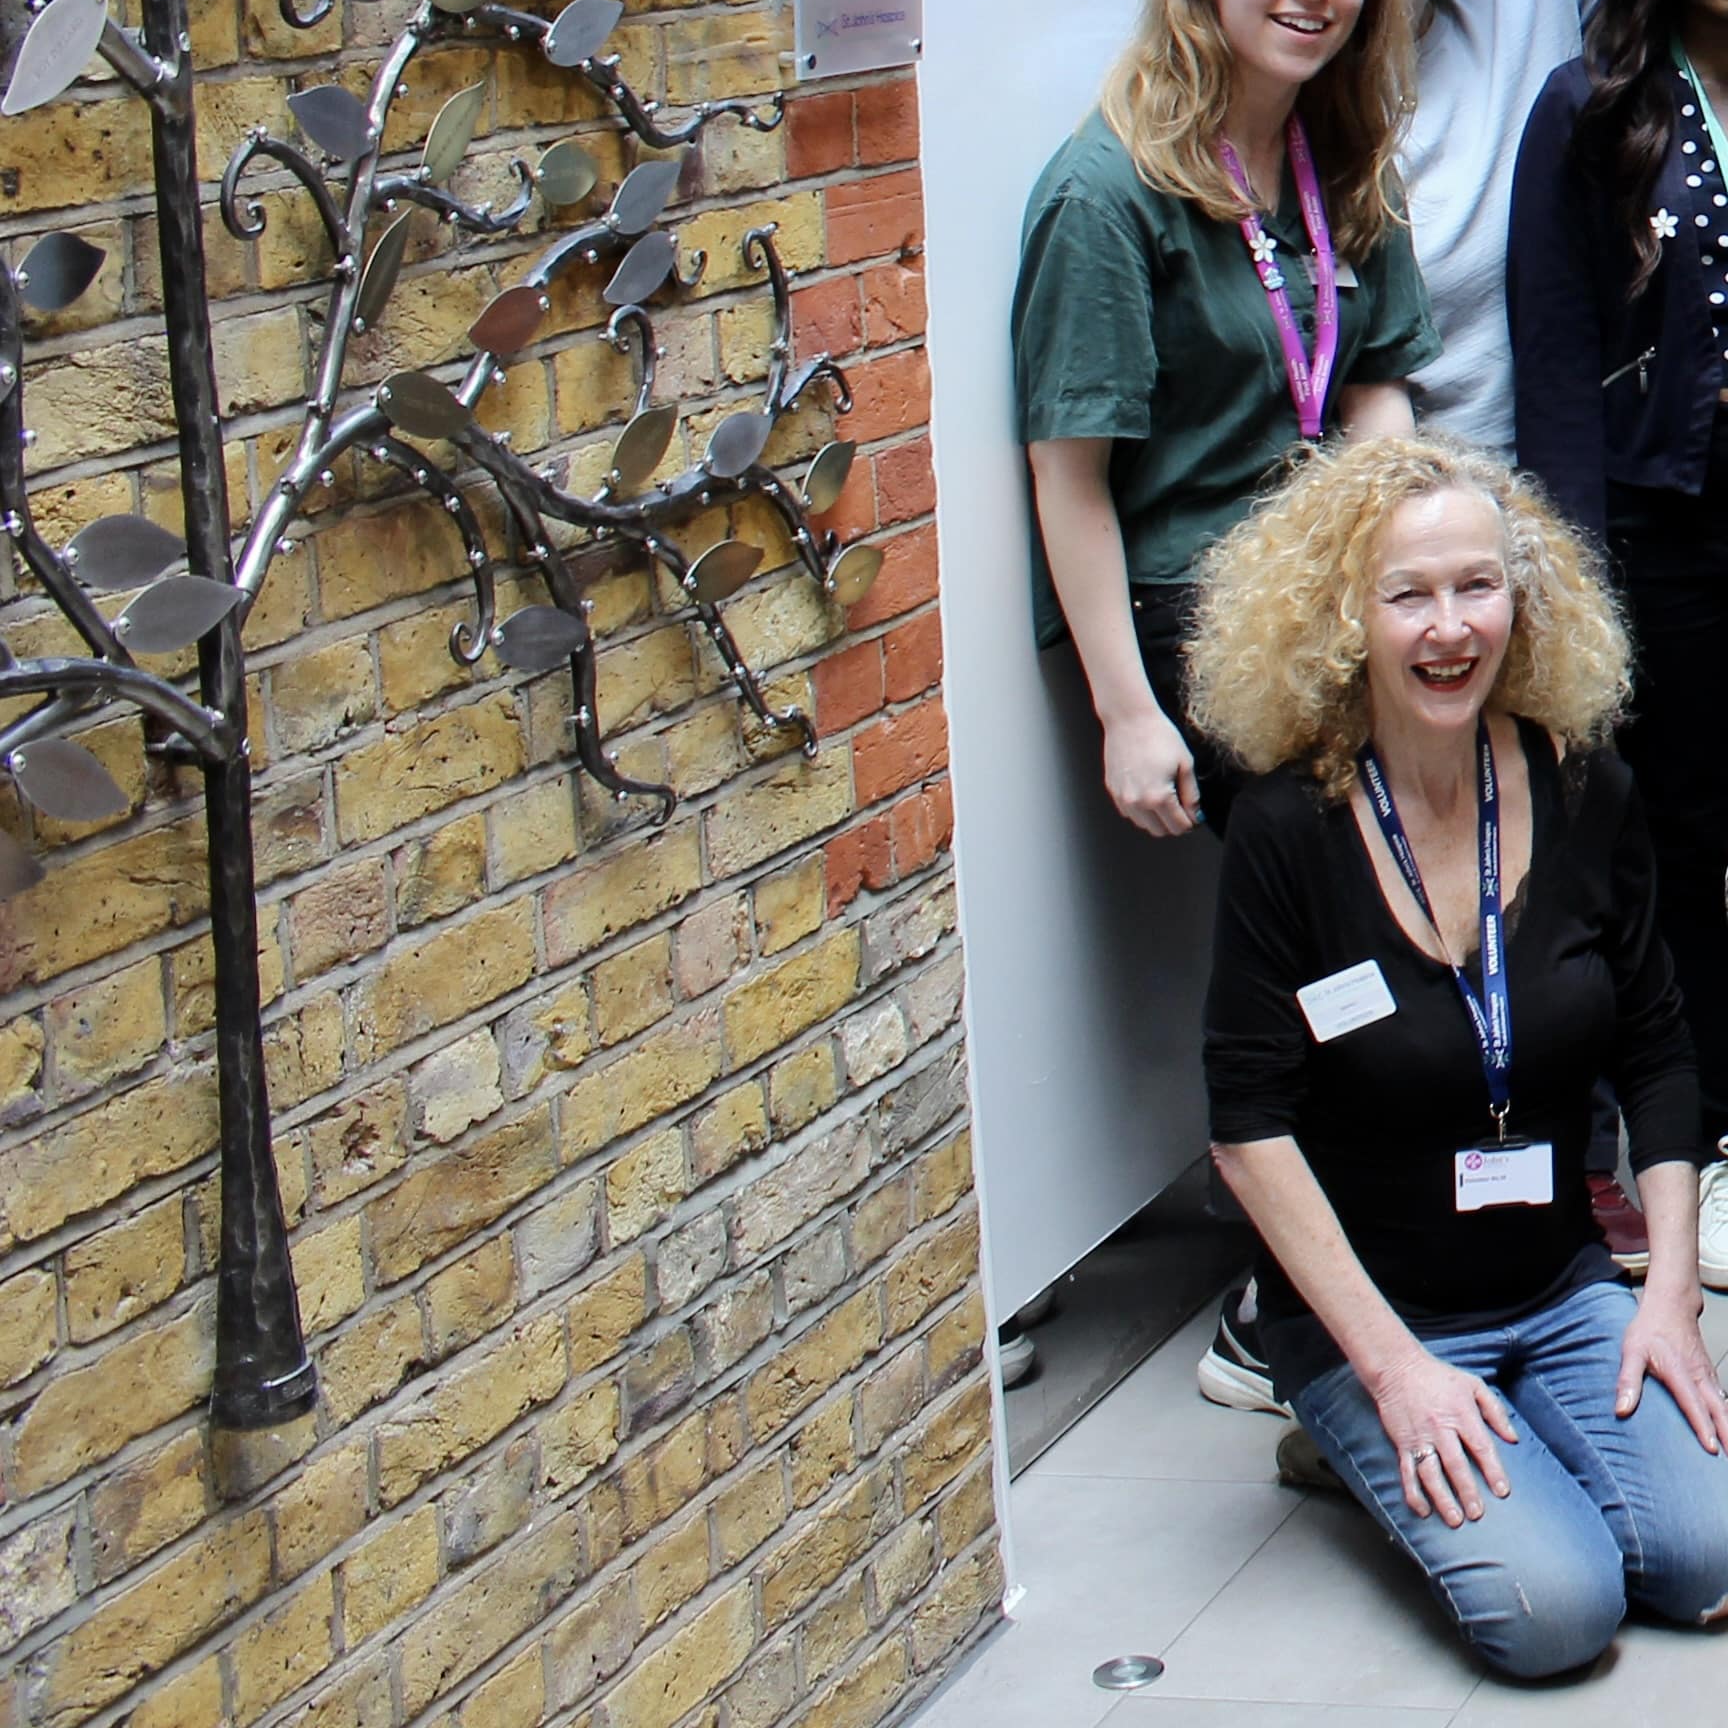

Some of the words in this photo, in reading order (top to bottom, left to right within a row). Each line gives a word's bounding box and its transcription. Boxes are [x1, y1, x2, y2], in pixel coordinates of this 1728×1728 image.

[1365, 758, 1391, 818] VOLUNTEER
[1484, 743, 1495, 803] VOLUNTEER
[1486, 914, 1497, 976] VOLUNTEER
